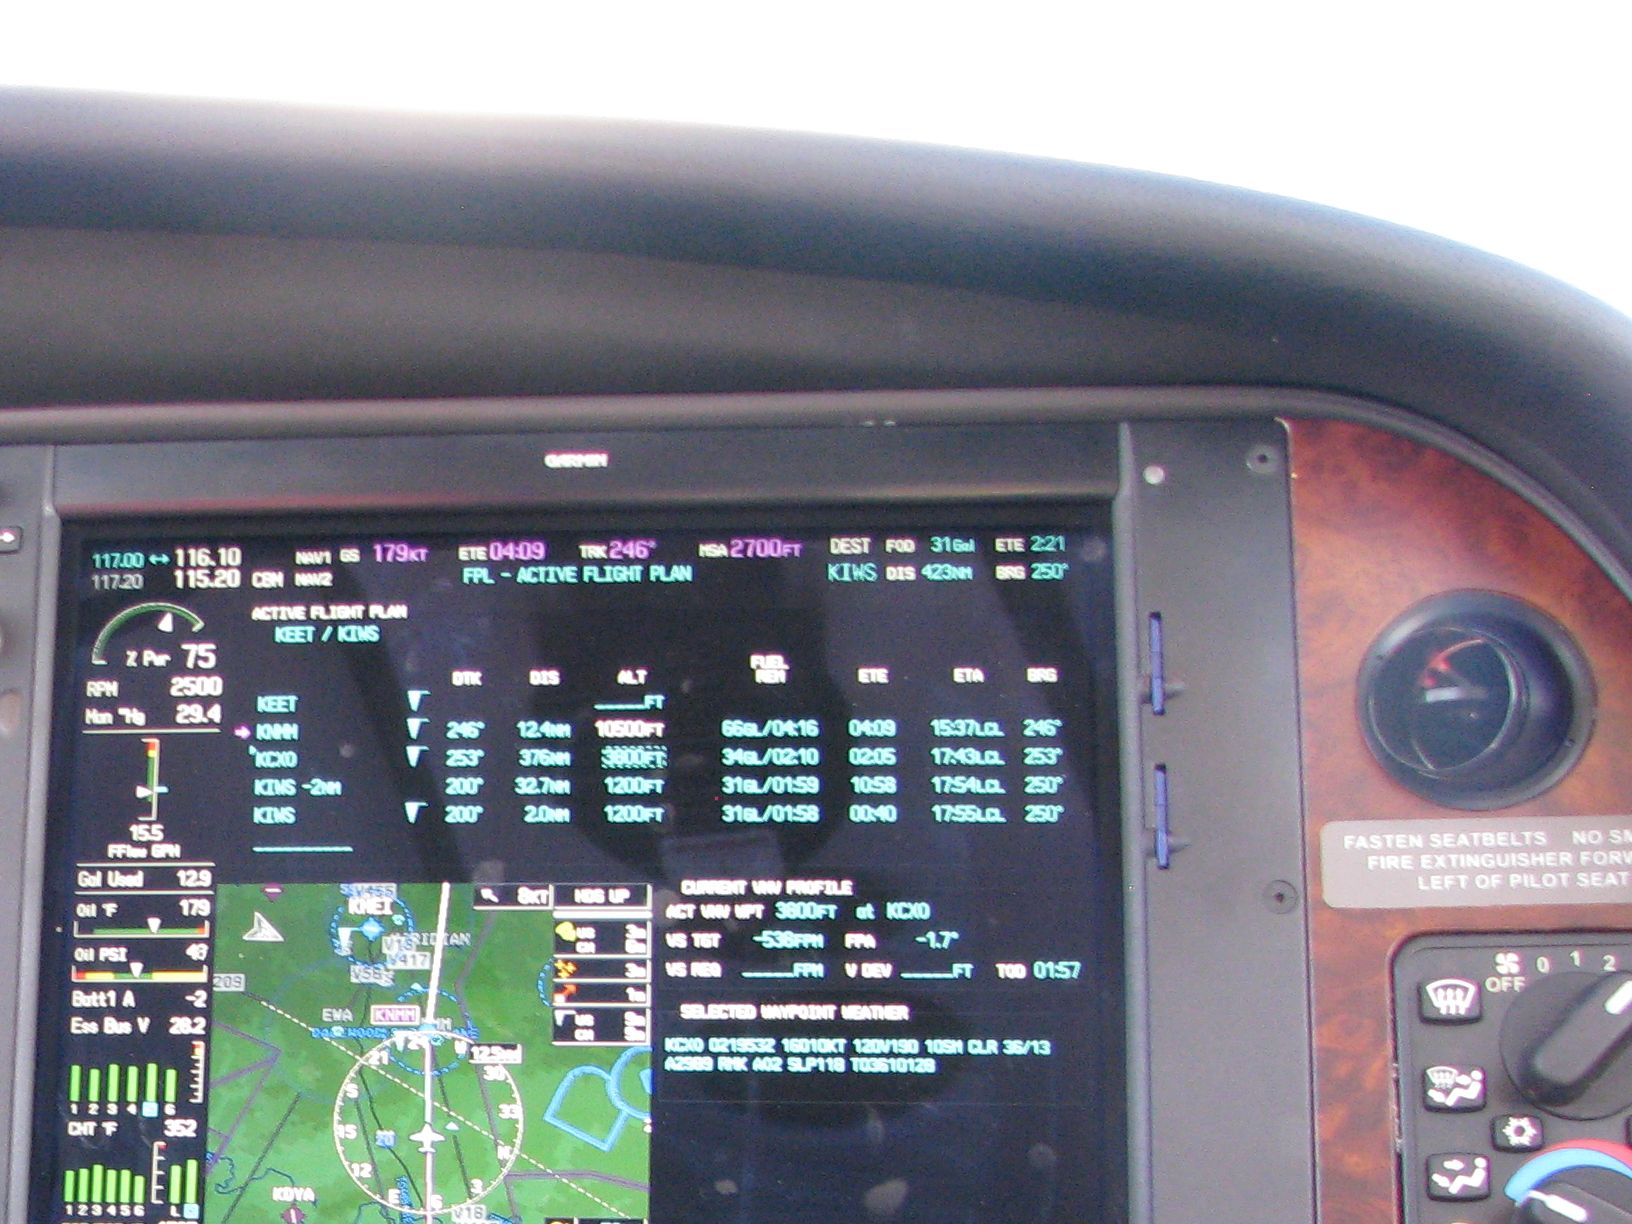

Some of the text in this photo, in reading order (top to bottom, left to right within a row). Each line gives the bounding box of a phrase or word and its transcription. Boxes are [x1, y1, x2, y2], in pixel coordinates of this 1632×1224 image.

[489, 541, 545, 561] 04:09
[830, 538, 871, 553] DEST
[995, 539, 1025, 552] ETE
[176, 548, 241, 566] 116.10
[175, 570, 240, 588] 115.20
[464, 564, 692, 583] FPL ACTIVE FLIGHT PLAN
[886, 567, 915, 580] DIS
[182, 644, 216, 668] 75
[171, 677, 222, 696] 2500
[530, 671, 560, 685] DIS
[1344, 830, 1603, 848] FASTEN SEATBELTS NO
[1368, 852, 1574, 870] FIRE EXTINGUISHER
[1418, 872, 1627, 890] LEFT OF PILOT SEAT
[1537, 957, 1550, 973] 0
[1570, 951, 1581, 967] 1
[1603, 956, 1616, 971] 2
[1486, 978, 1525, 992] OFF
